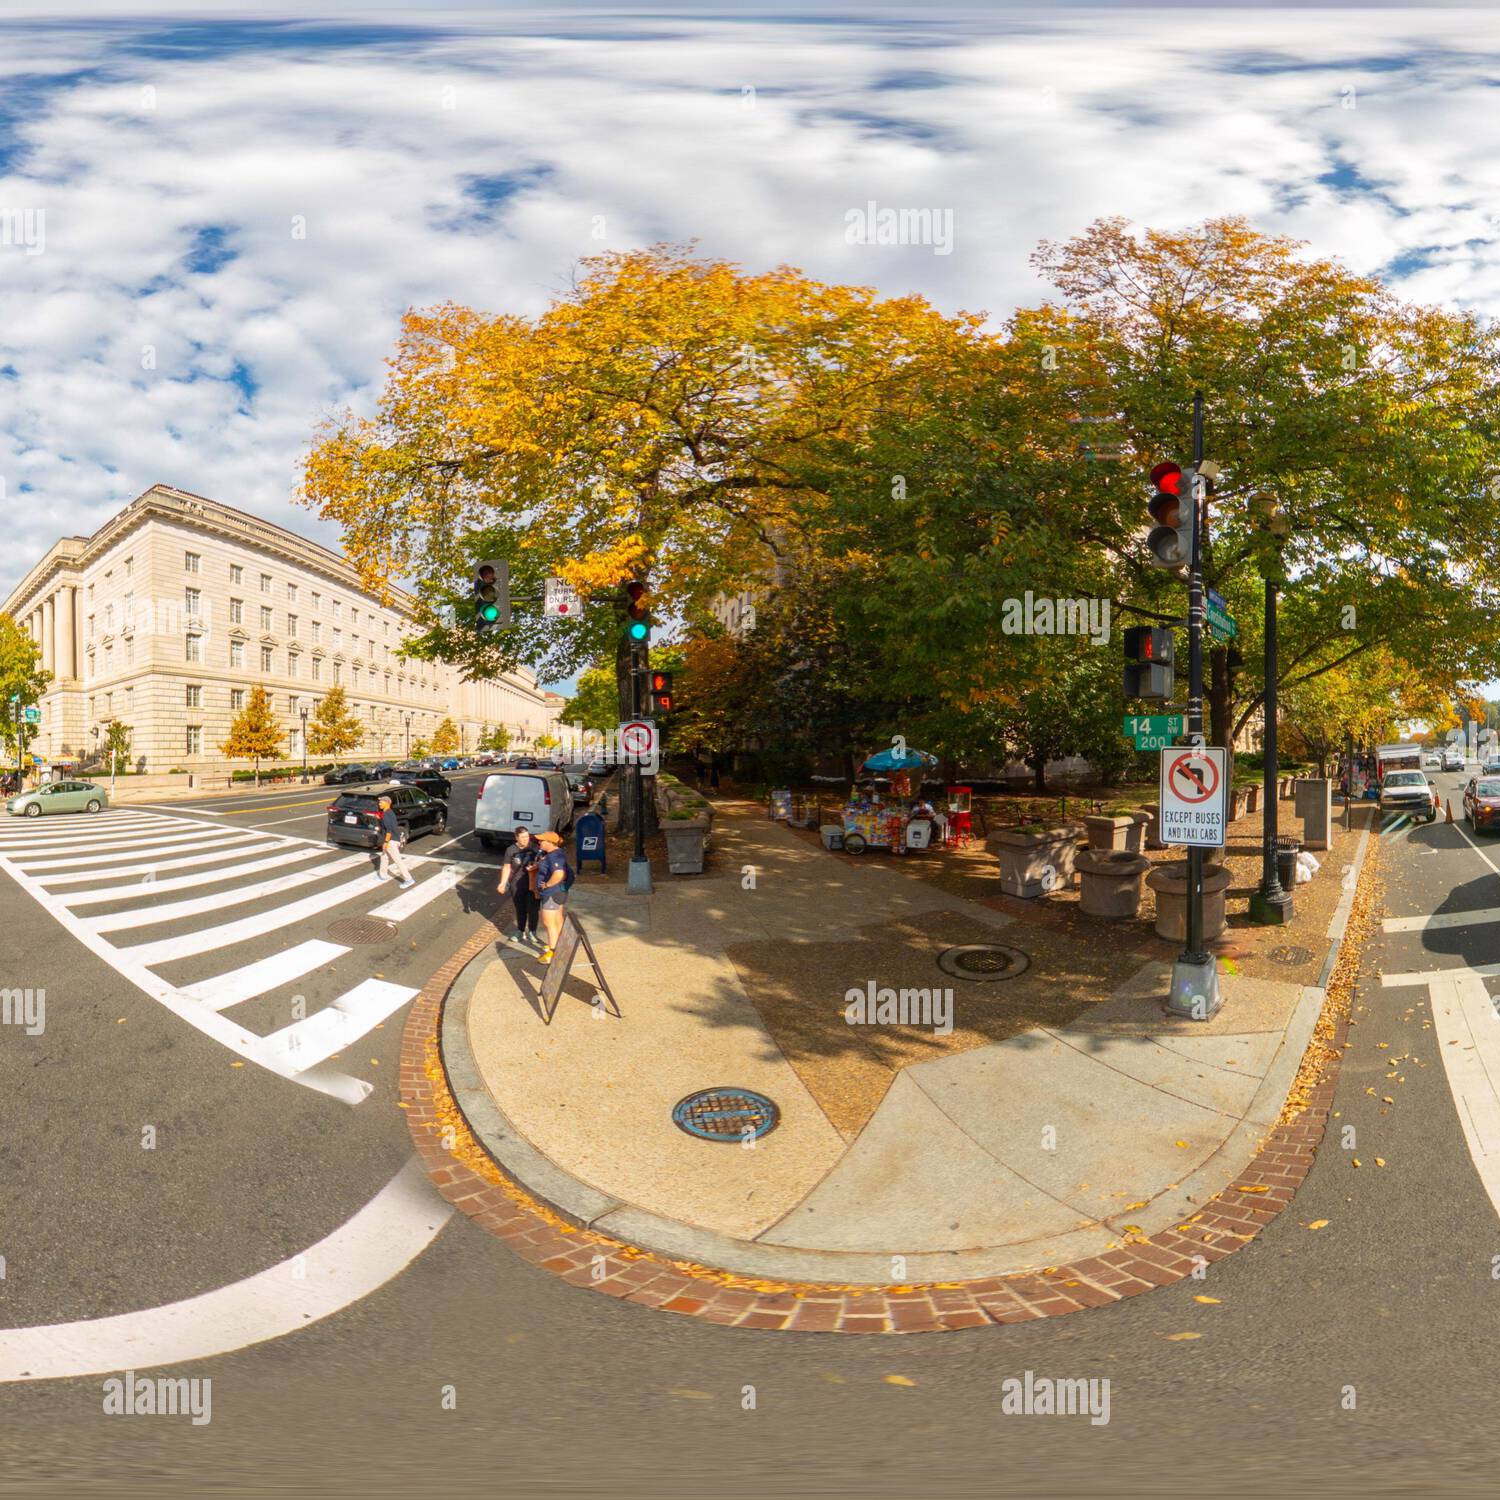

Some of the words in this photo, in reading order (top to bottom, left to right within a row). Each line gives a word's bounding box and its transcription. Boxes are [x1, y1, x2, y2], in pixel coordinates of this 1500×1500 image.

[1130, 718, 1152, 735] 14
[1167, 717, 1178, 726] ST
[1167, 726, 1179, 734] NW
[1141, 736, 1166, 748] 200
[1165, 811, 1192, 824] EXCEPT
[1195, 812, 1221, 825] BUSES
[1167, 828, 1181, 839] AND
[1183, 828, 1198, 840] TAXI
[1200, 828, 1218, 841] CABS
